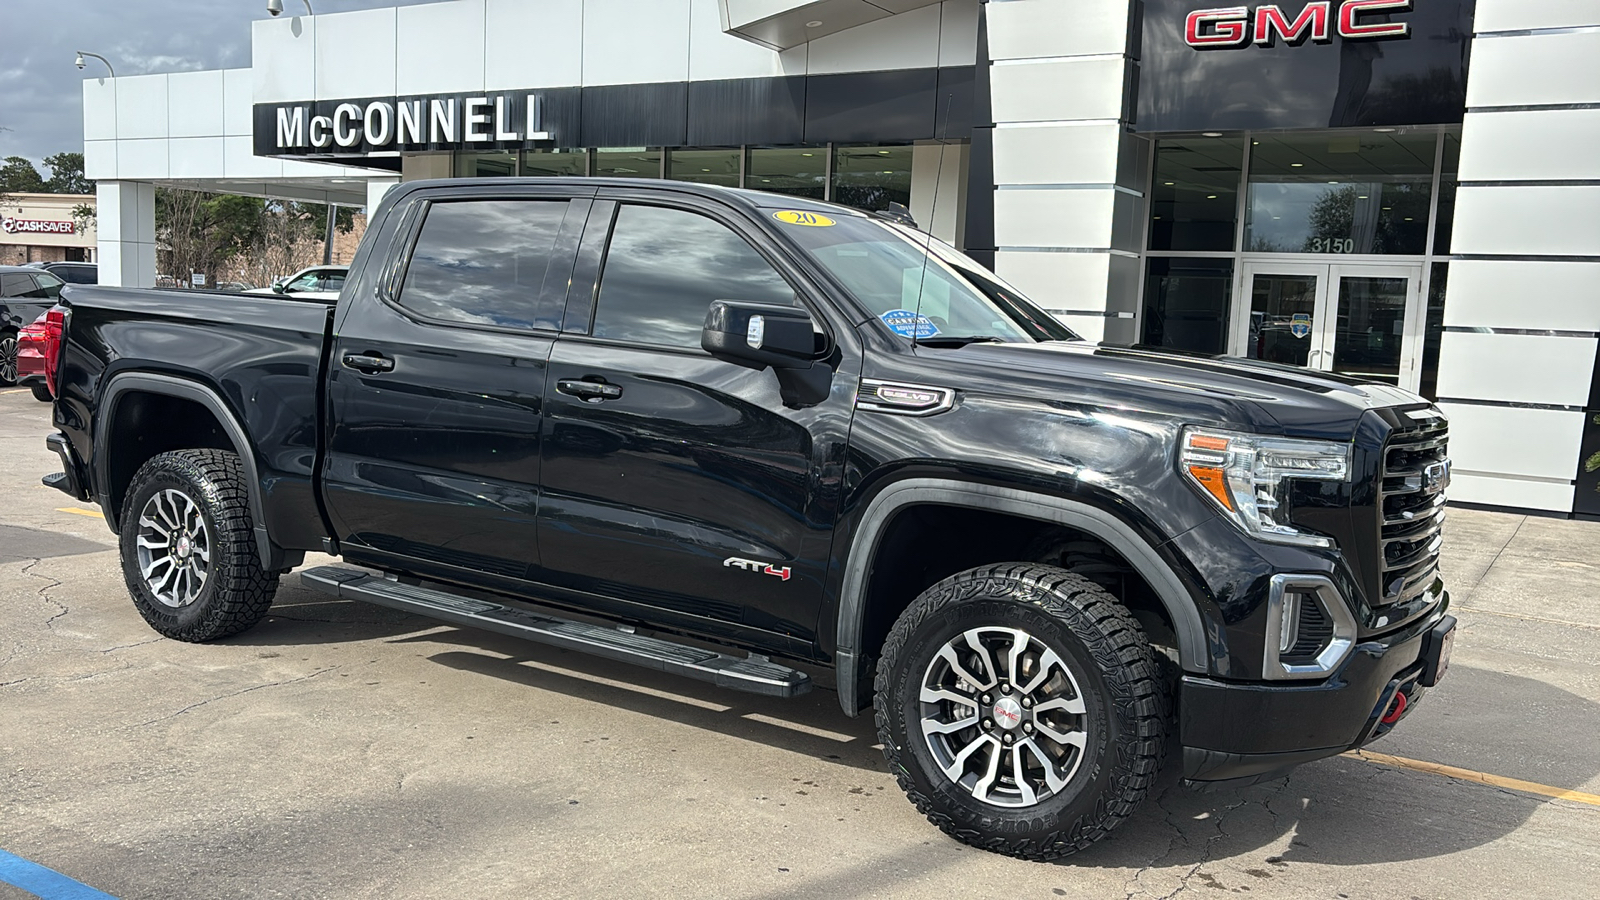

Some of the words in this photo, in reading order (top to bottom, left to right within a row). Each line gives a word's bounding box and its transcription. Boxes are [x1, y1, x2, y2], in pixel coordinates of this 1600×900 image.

[1185, 0, 1409, 47] GMC
[789, 211, 817, 224] 20
[1311, 237, 1354, 254] 3150
[723, 556, 792, 582] AT4
[994, 705, 1019, 722] GMC
